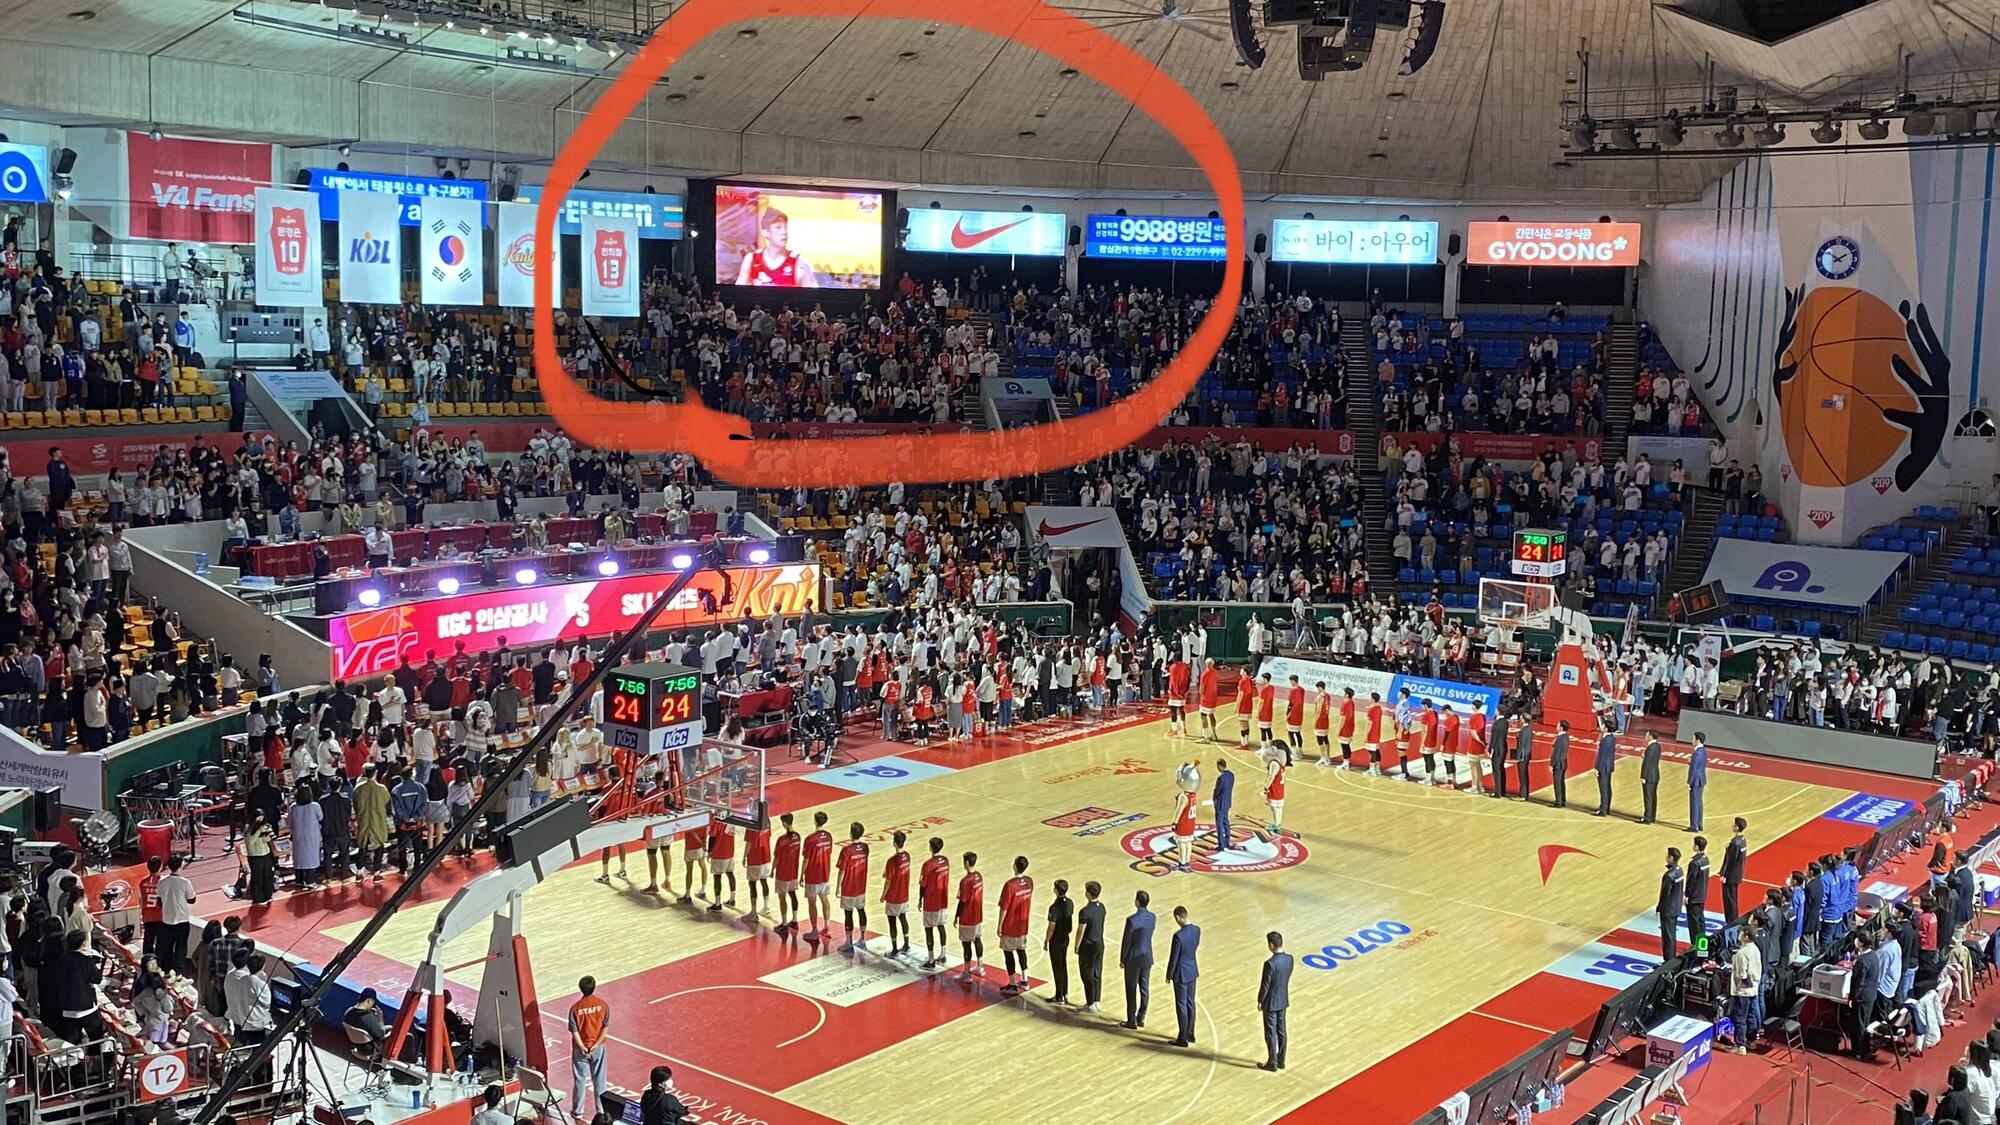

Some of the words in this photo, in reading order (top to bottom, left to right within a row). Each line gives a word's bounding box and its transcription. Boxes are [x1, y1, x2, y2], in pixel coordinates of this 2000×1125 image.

[151, 182, 189, 209] V4
[194, 187, 255, 212] Fans
[1120, 218, 1212, 243] 9988병원
[280, 240, 300, 263] 10
[350, 238, 391, 264] KBL
[1489, 242, 1613, 260] GYODONG
[602, 259, 619, 280] 13
[1812, 511, 1830, 521] 209
[1521, 545, 1542, 560] 24
[622, 593, 644, 616] SK
[437, 611, 472, 638] KGC
[475, 602, 548, 633] 인삼공사
[616, 679, 645, 695] 7:56
[665, 676, 696, 693] 7:56
[1402, 683, 1445, 697] POCARI
[1447, 689, 1490, 703] SWEAT
[614, 696, 639, 722] 24
[662, 694, 689, 722] 24
[616, 729, 638, 749] KCC
[664, 728, 688, 748] KCC
[1302, 920, 1411, 970] 00700
[578, 1006, 602, 1015] STAFF
[149, 1064, 178, 1086] T2
